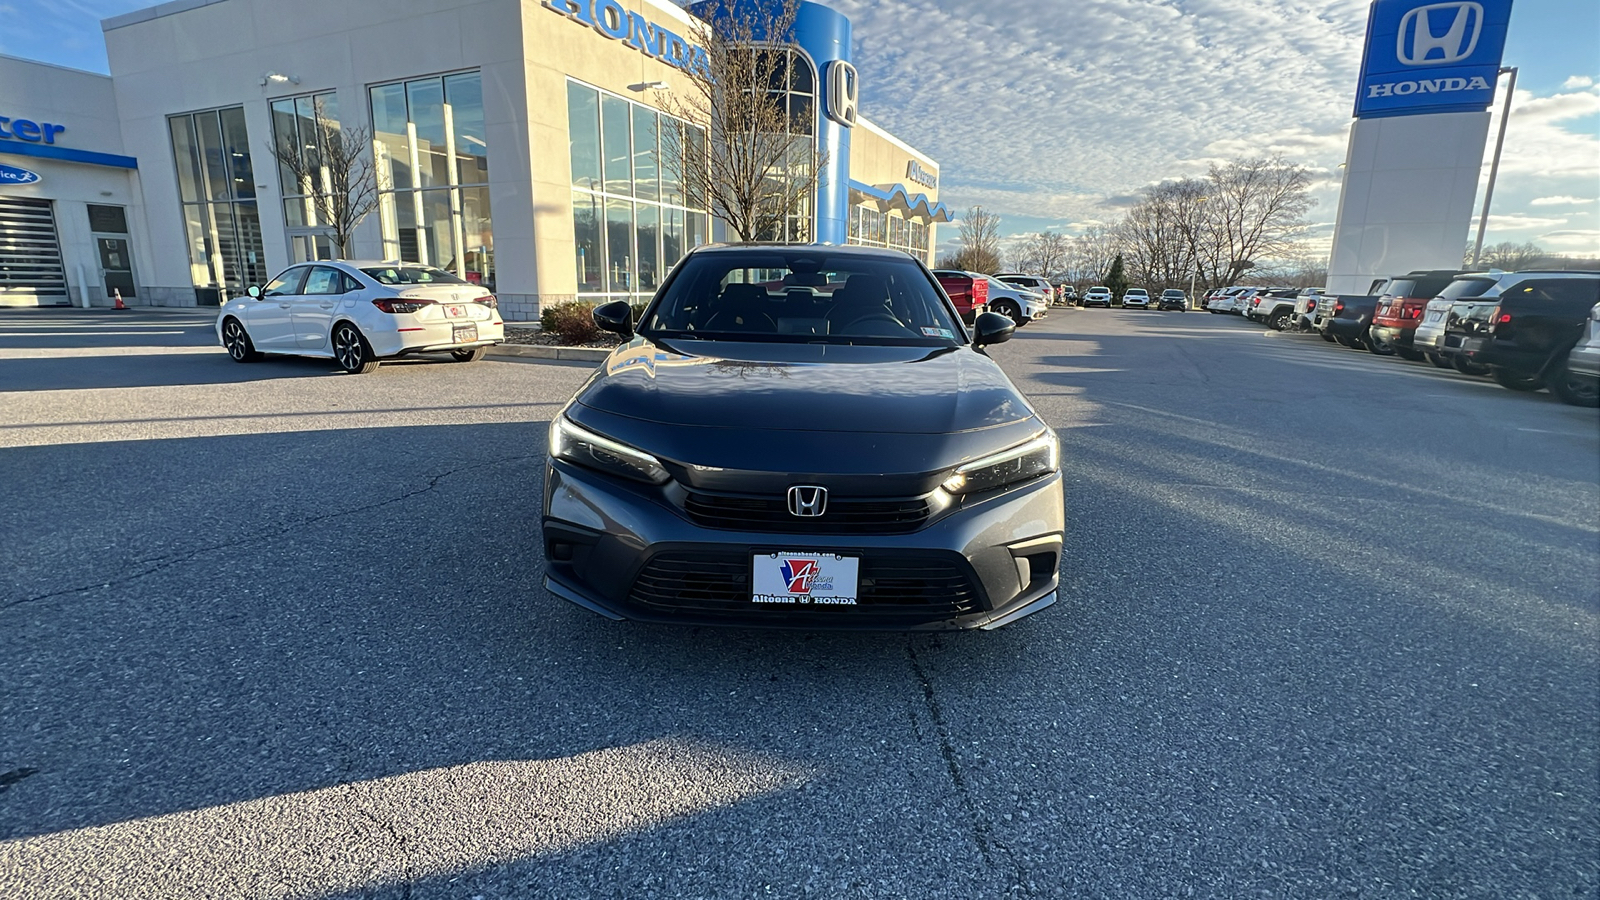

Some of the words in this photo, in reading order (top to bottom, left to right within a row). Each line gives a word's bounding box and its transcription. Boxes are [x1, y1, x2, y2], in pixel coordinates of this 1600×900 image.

[1367, 76, 1491, 98] HONDA
[752, 594, 796, 604] Altoona
[813, 597, 858, 605] HONDA
